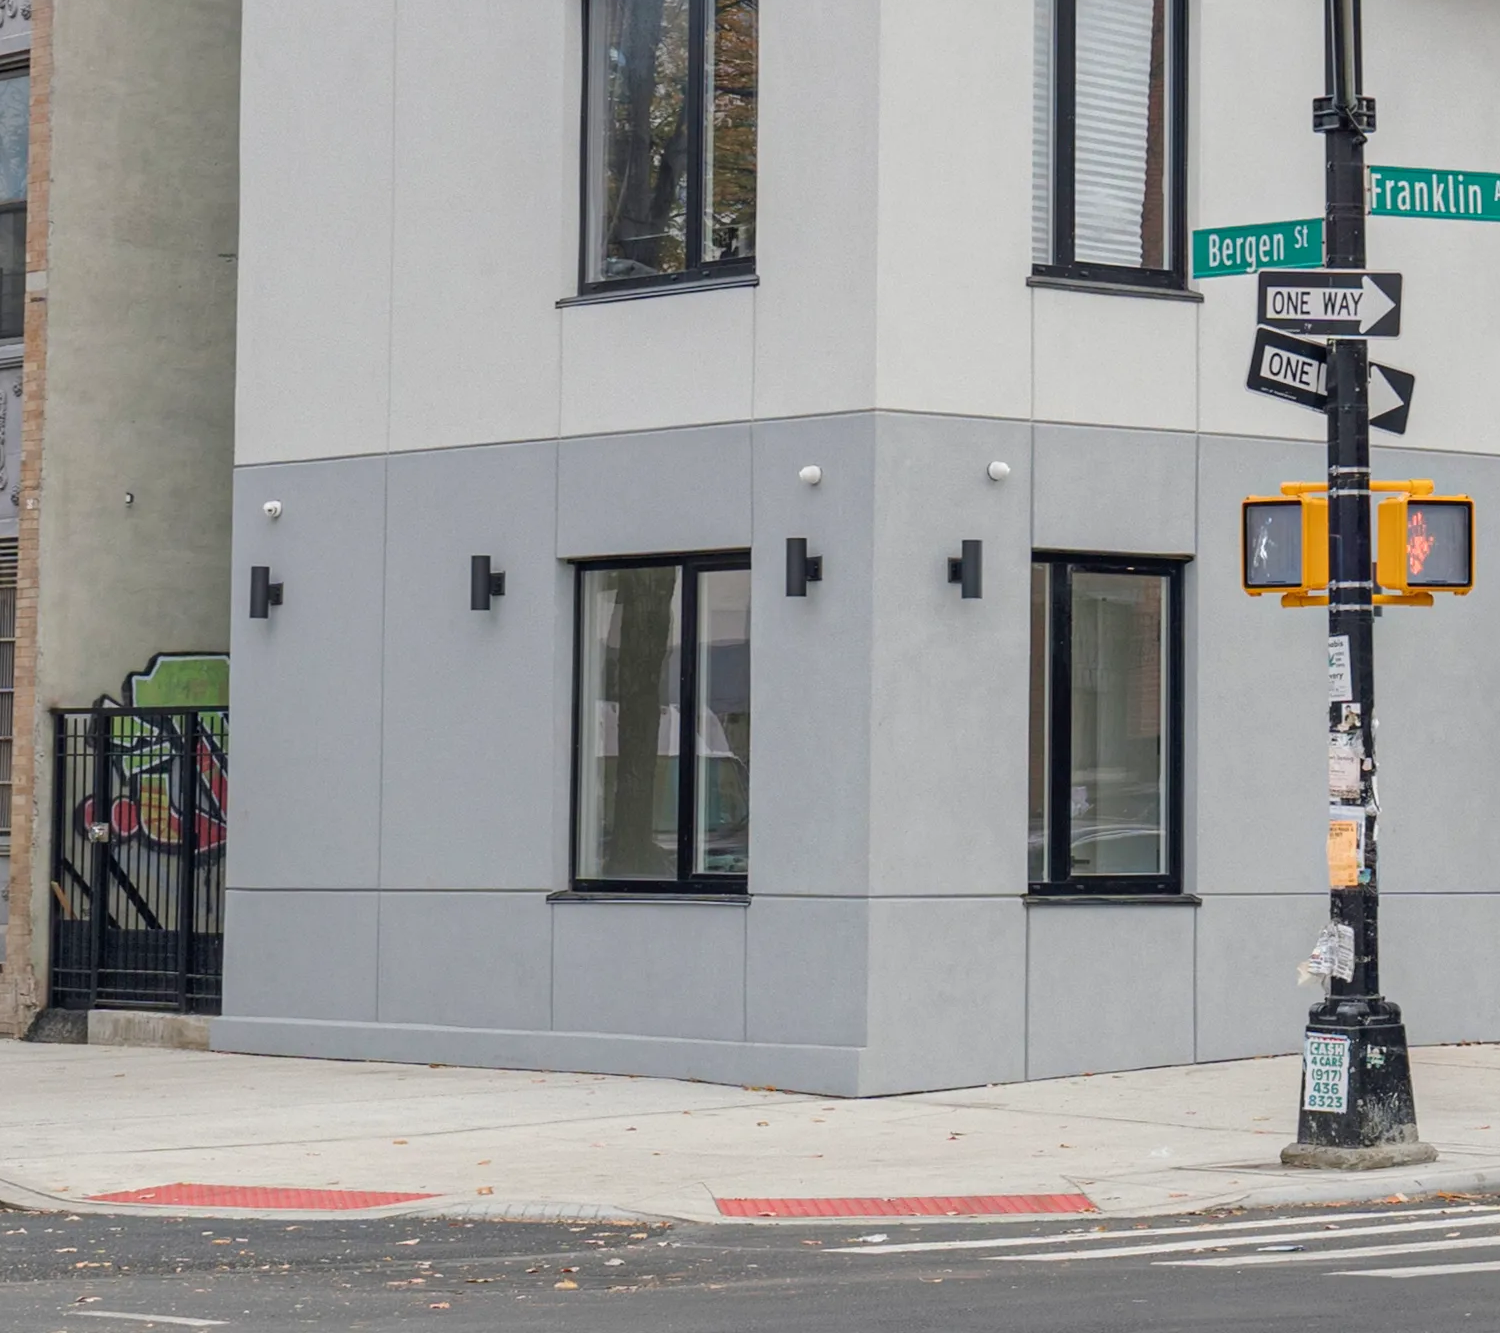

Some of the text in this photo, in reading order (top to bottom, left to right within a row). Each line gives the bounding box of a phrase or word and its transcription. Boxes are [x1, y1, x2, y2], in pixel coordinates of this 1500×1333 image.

[1371, 173, 1482, 214] Franklin
[1208, 225, 1308, 273] Bergen St
[1272, 291, 1363, 316] ONE WAY
[1268, 352, 1313, 386] ONE
[1311, 1057, 1318, 1066] 4
[1311, 1069, 1342, 1082] (917)
[1313, 1082, 1339, 1095] 436
[1308, 1094, 1343, 1108] 8323
